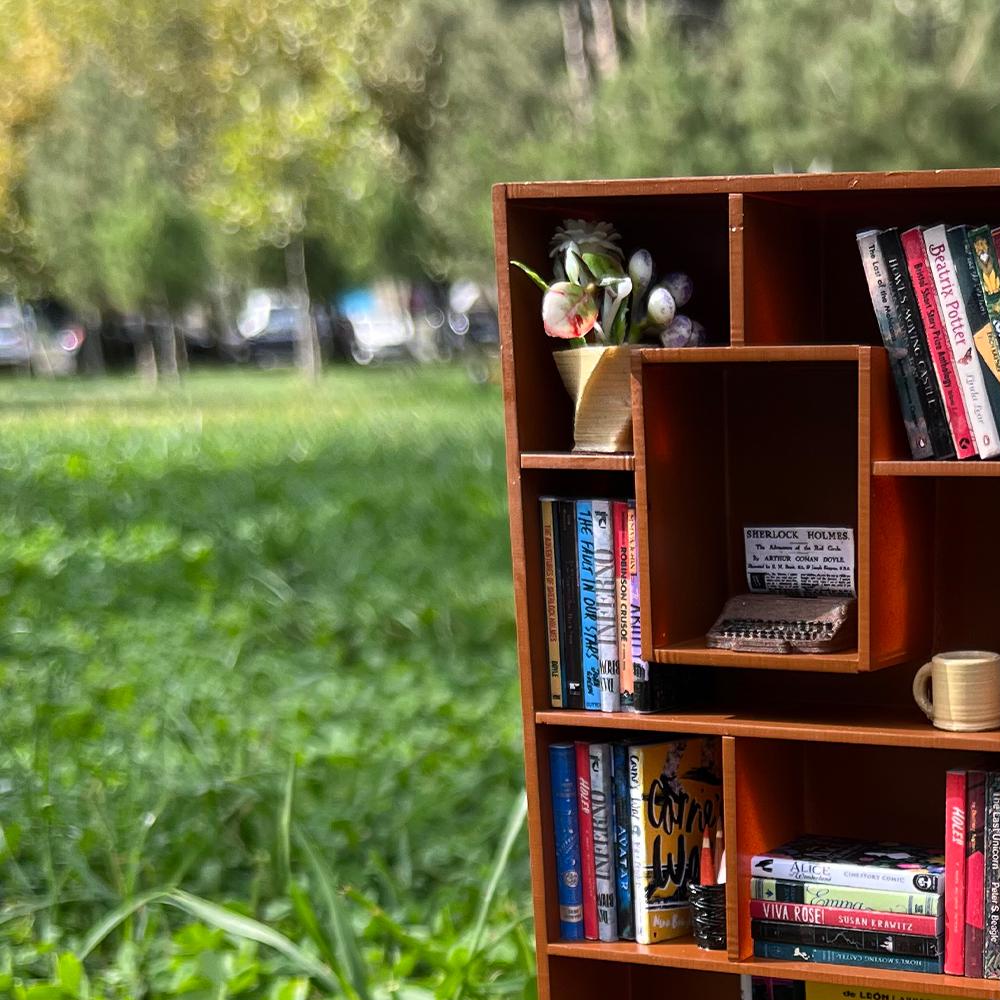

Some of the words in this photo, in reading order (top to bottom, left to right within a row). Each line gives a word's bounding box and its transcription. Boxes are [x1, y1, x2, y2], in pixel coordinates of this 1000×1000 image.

[867, 244, 877, 259] The
[871, 261, 882, 277] Last
[913, 262, 927, 287] Bristol
[876, 278, 886, 288] of
[927, 241, 957, 299] Beatrix
[944, 299, 969, 346] Potter
[879, 290, 889, 302] the
[920, 287, 933, 308] Short
[882, 304, 899, 342] Mohicans
[924, 309, 938, 330] Story
[931, 330, 944, 350] Prize
[901, 307, 923, 356] MOVING
[916, 359, 937, 406] CASTLE
[935, 350, 955, 388] Anthology
[579, 510, 593, 535] THE
[747, 530, 798, 539] SHERLOCK
[580, 541, 595, 575] FAULT
[582, 579, 596, 592] IN
[620, 547, 628, 601] ROBINSON
[584, 597, 597, 619] OUR
[620, 603, 628, 642] CRUSOE
[585, 627, 599, 660] STARS
[951, 806, 965, 846] HOLES
[618, 825, 629, 891] AVATAR
[991, 833, 1000, 870] Unicorn
[790, 861, 831, 876] ALICE
[806, 886, 863, 910] Emma
[991, 882, 1000, 904] Peter
[794, 906, 825, 924] ROSE!
[838, 916, 867, 926] SUSAN
[871, 919, 913, 931] KRAWITZ
[989, 915, 999, 942] Beagle
[843, 989, 856, 999] de
